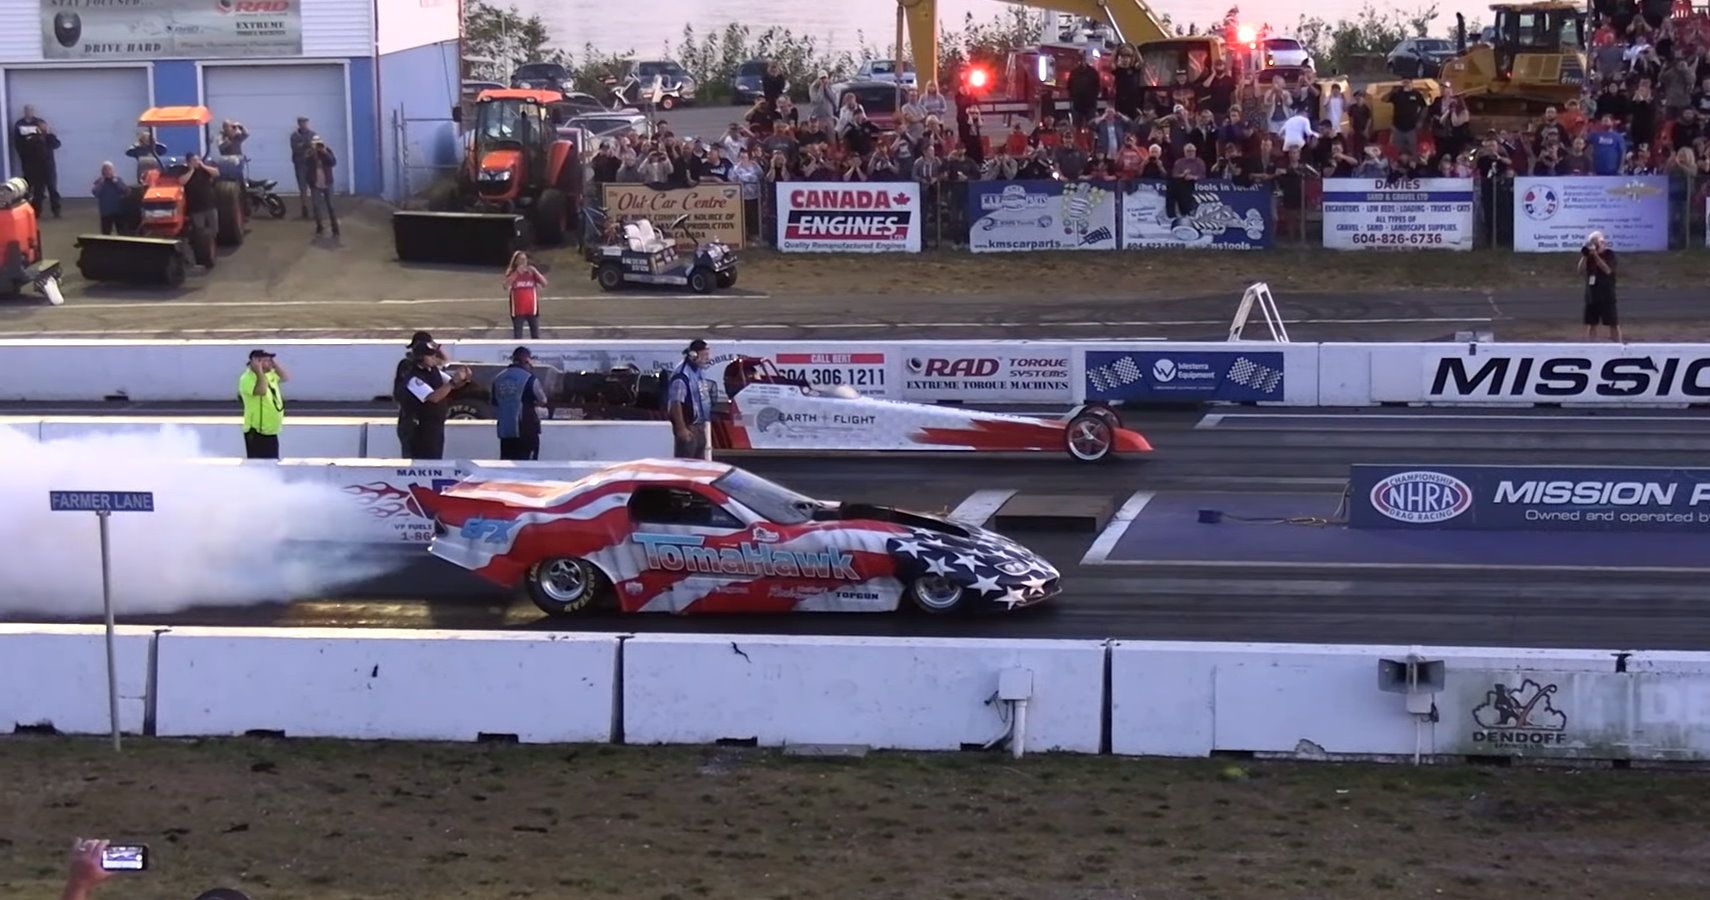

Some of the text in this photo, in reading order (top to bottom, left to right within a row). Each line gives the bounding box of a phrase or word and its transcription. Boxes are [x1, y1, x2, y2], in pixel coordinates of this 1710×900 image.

[236, 21, 285, 29] EXTREME
[84, 43, 162, 53] DRIVE HARD
[1375, 179, 1420, 190] DAVIES
[618, 192, 728, 210] Old Car Centre
[790, 190, 891, 209] CANADA
[798, 216, 898, 235] ENGINES
[1352, 233, 1442, 244] 604-826-6736
[876, 242, 906, 250] Engines
[811, 355, 830, 363] CALL
[653, 361, 674, 370] Best
[924, 358, 1068, 377] RAD TORQUE
[779, 369, 884, 385] 04306.1211
[1178, 371, 1216, 379] Equipment
[907, 381, 1069, 389] EXTREME TORQUE MACHINES
[779, 414, 876, 424] EARTH FLIGHT
[397, 469, 442, 477] MAKIN
[1389, 474, 1455, 487] CHAMPIONSHIP
[1389, 482, 1455, 511] NHRA
[1493, 481, 1678, 505] MISSION
[52, 493, 152, 508] FARMER LANE
[1389, 508, 1453, 520] DRAG RACING
[1525, 510, 1580, 520] Owned
[1586, 511, 1614, 521] and
[1620, 511, 1693, 523] operated
[632, 532, 860, 580] TomaHawk
[836, 592, 879, 600] TOPGUN
[1473, 732, 1566, 744] DENDOFF
